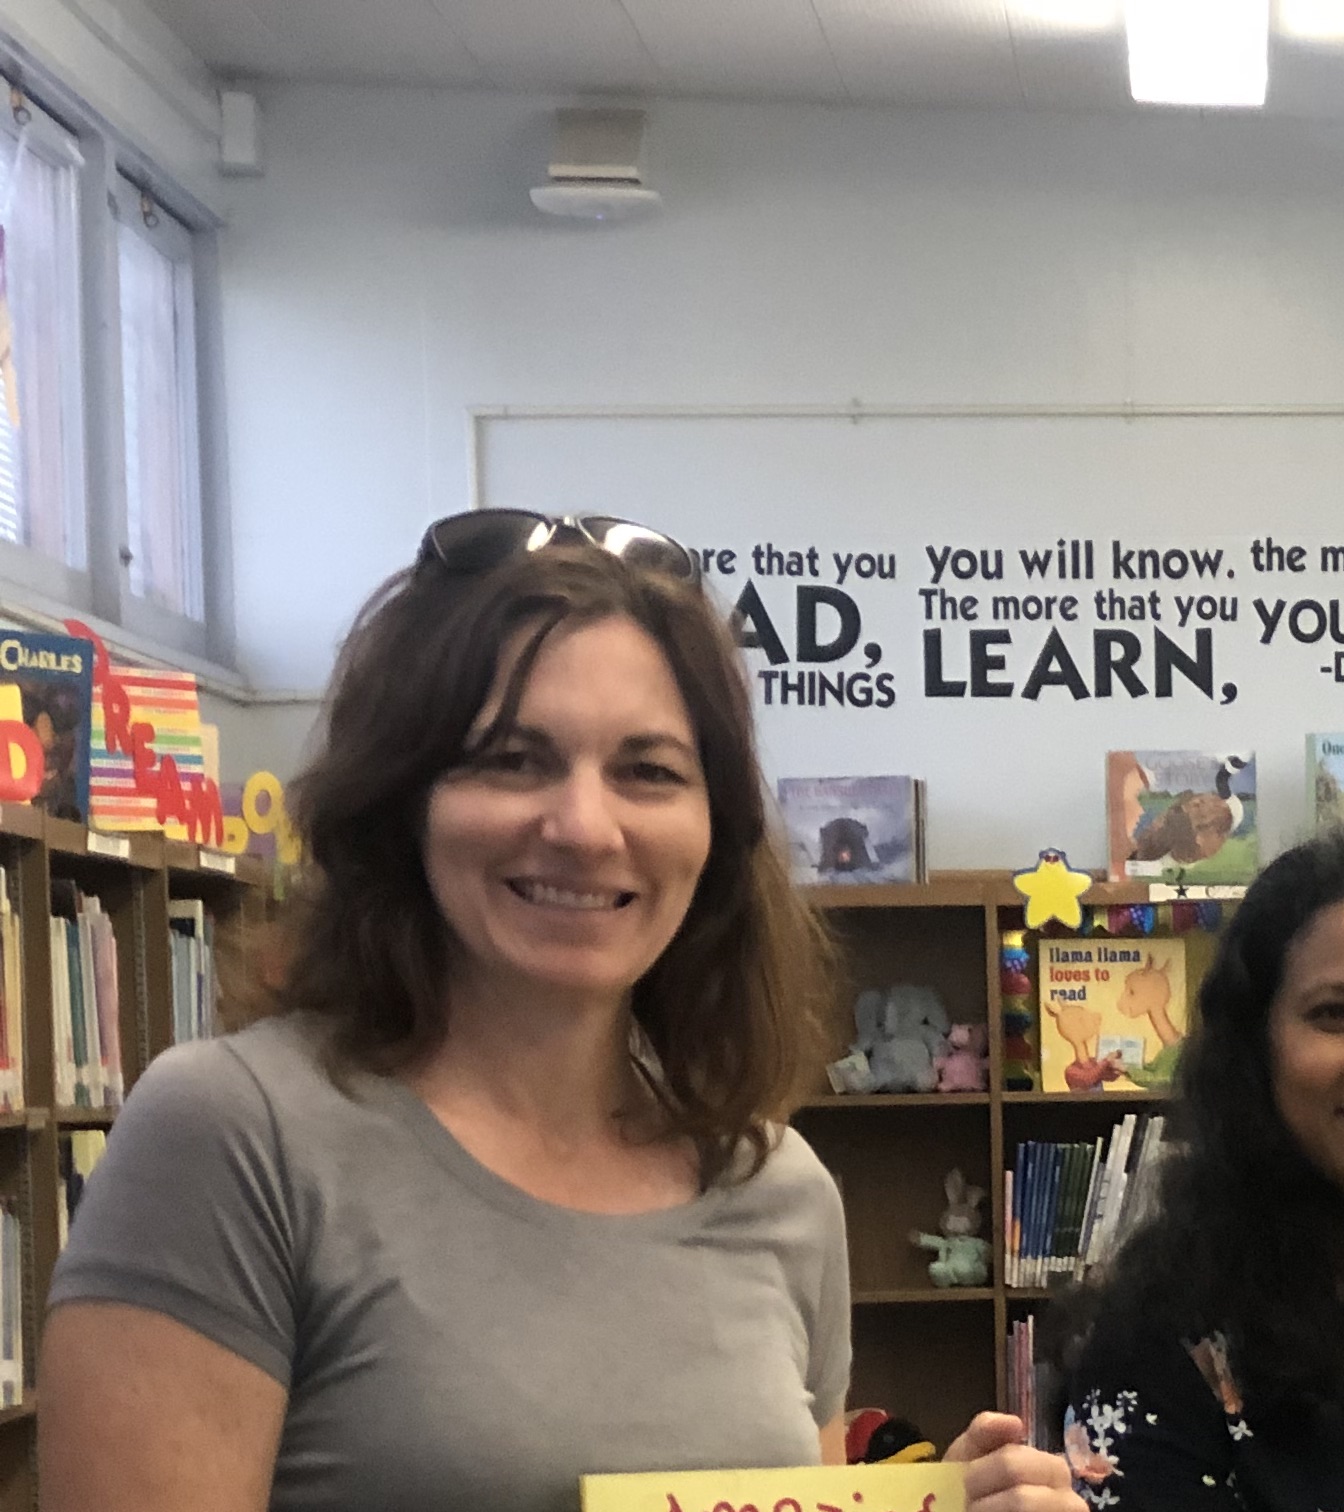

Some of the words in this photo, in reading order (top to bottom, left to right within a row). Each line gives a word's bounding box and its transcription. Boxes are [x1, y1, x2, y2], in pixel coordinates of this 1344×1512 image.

[751, 543, 819, 577] that
[832, 551, 896, 585] you
[925, 544, 1004, 584] you
[1018, 537, 1094, 580] will
[1111, 539, 1235, 580] know.
[1250, 536, 1307, 573] the
[727, 577, 882, 668] AD,
[918, 587, 980, 621] The
[991, 594, 1079, 622] more
[1093, 588, 1162, 622] that
[1173, 595, 1238, 628] you
[922, 624, 1238, 706] LEARN,
[757, 669, 896, 709] THINGS
[1049, 967, 1091, 983] loves
[1094, 967, 1110, 983] to
[1049, 986, 1087, 1001] read
